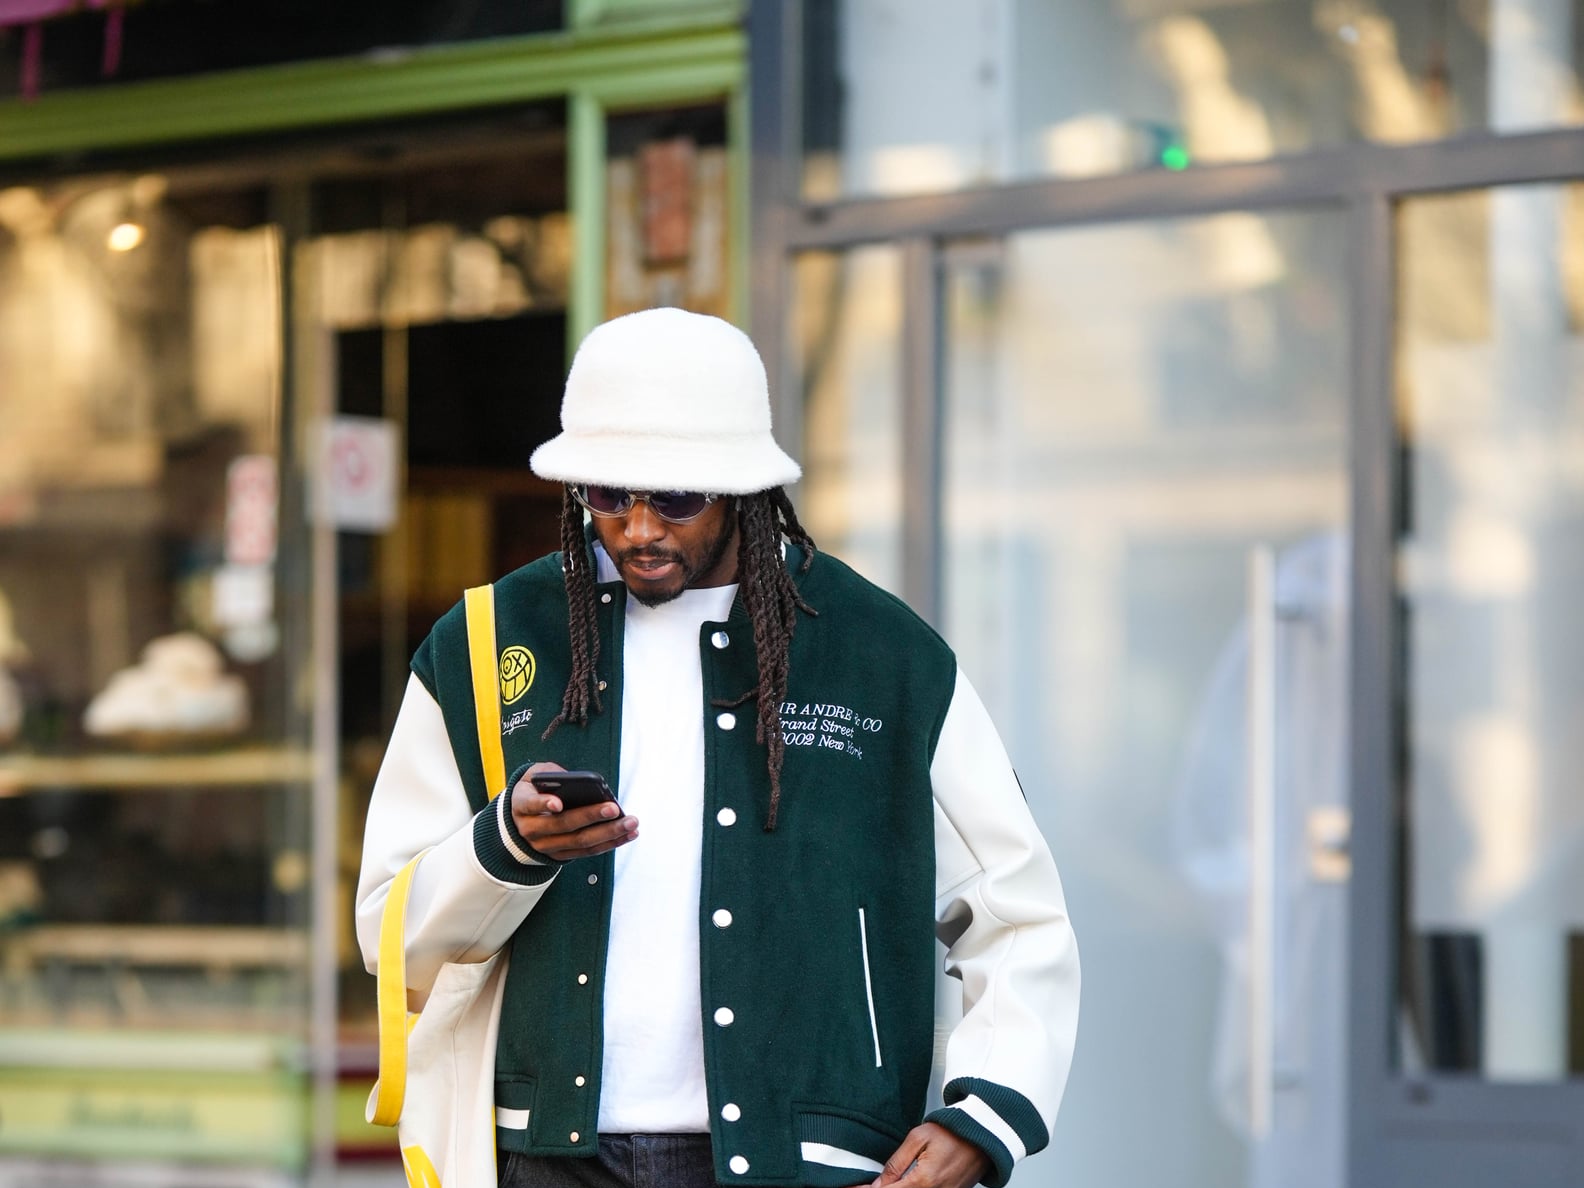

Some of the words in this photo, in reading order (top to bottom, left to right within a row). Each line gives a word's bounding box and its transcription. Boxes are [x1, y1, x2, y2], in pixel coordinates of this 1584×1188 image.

[800, 703, 853, 720] ANDRE
[862, 717, 883, 732] CO
[779, 718, 818, 731] rand
[820, 719, 855, 738] Street
[818, 734, 845, 751] New
